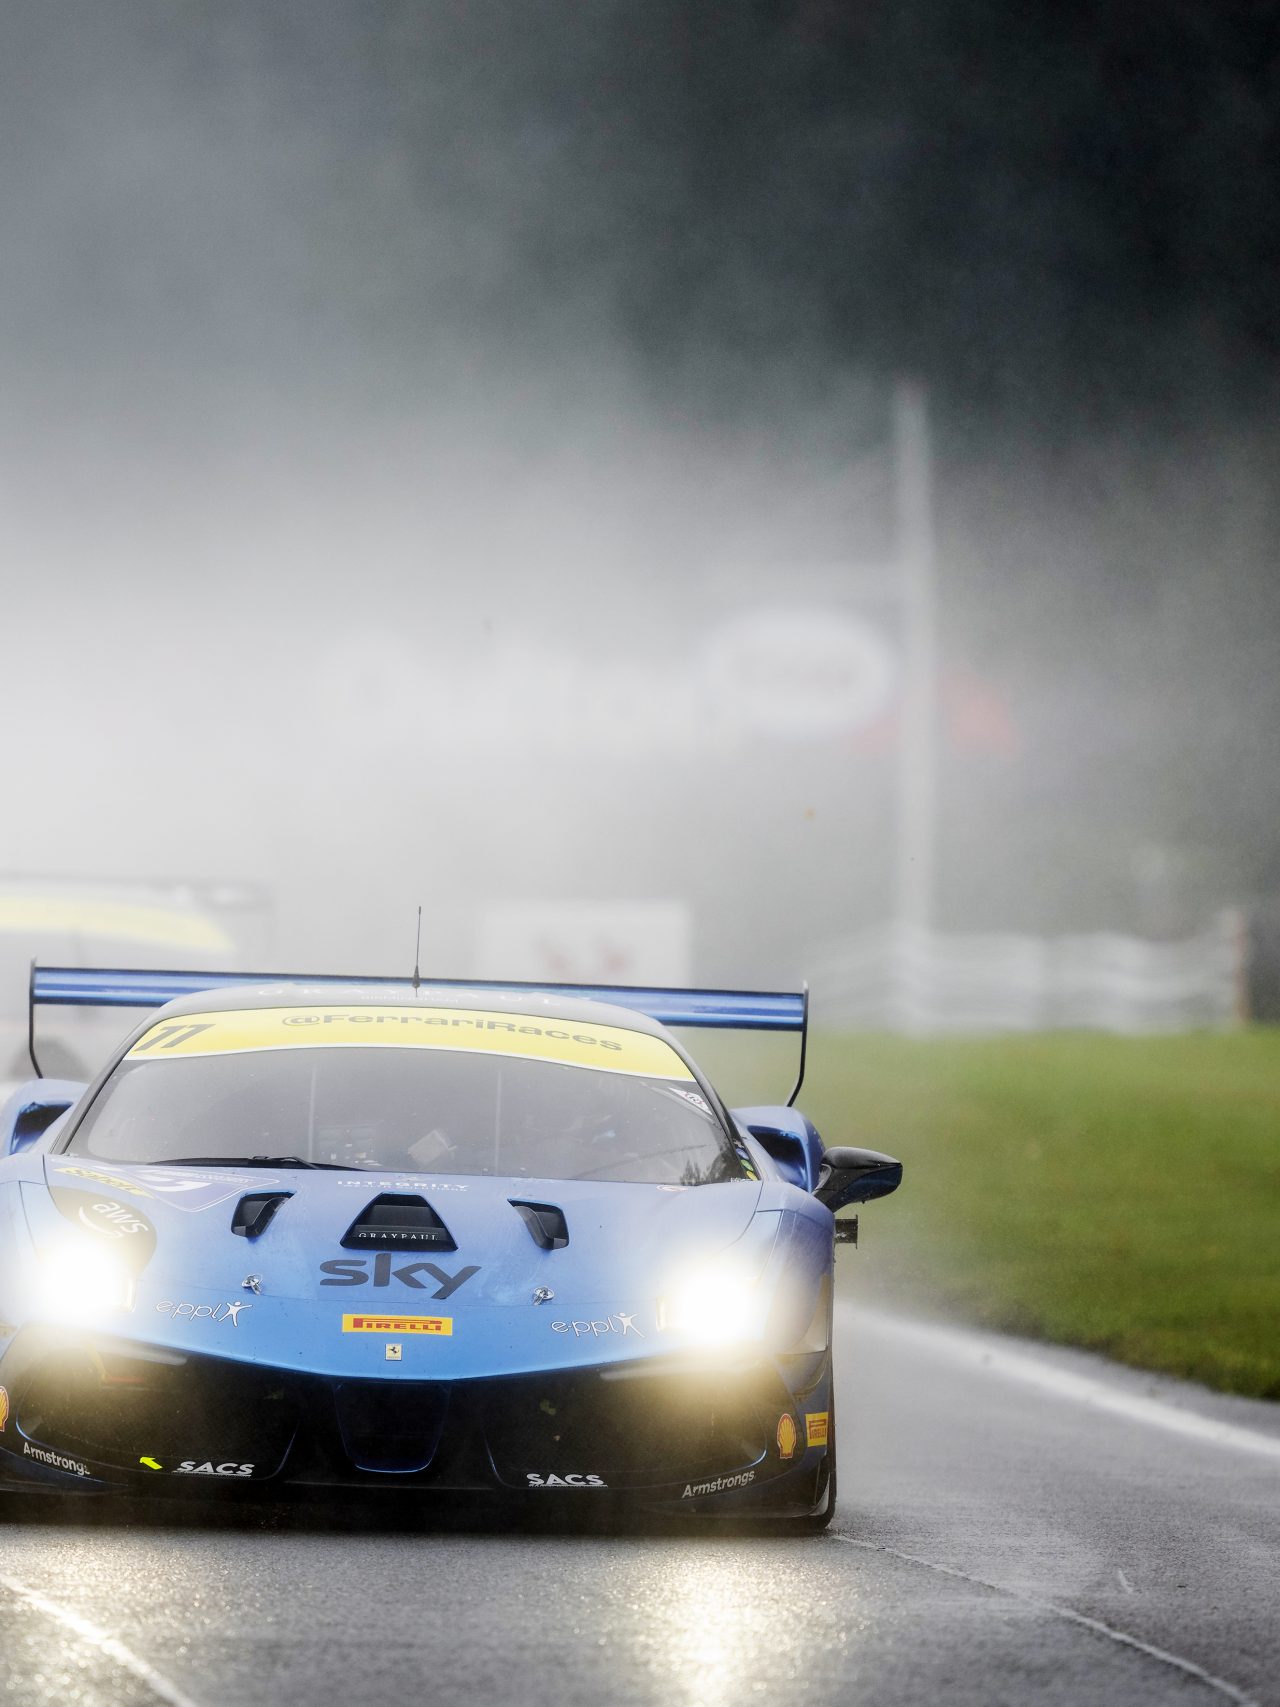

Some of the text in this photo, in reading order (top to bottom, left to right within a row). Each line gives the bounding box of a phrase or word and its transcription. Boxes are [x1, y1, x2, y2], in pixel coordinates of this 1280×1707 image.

[133, 1023, 217, 1052] 11
[282, 1014, 622, 1051] @FerrariRaces
[337, 1180, 469, 1190] INTEGRITY
[91, 1201, 149, 1233] aws
[319, 1252, 483, 1300] sky
[352, 1317, 443, 1331] PIRELLI
[807, 1418, 827, 1441] PIRELLI
[177, 1460, 255, 1475] SACS
[526, 1473, 605, 1486] SACS
[681, 1469, 756, 1499] Armstrongs
